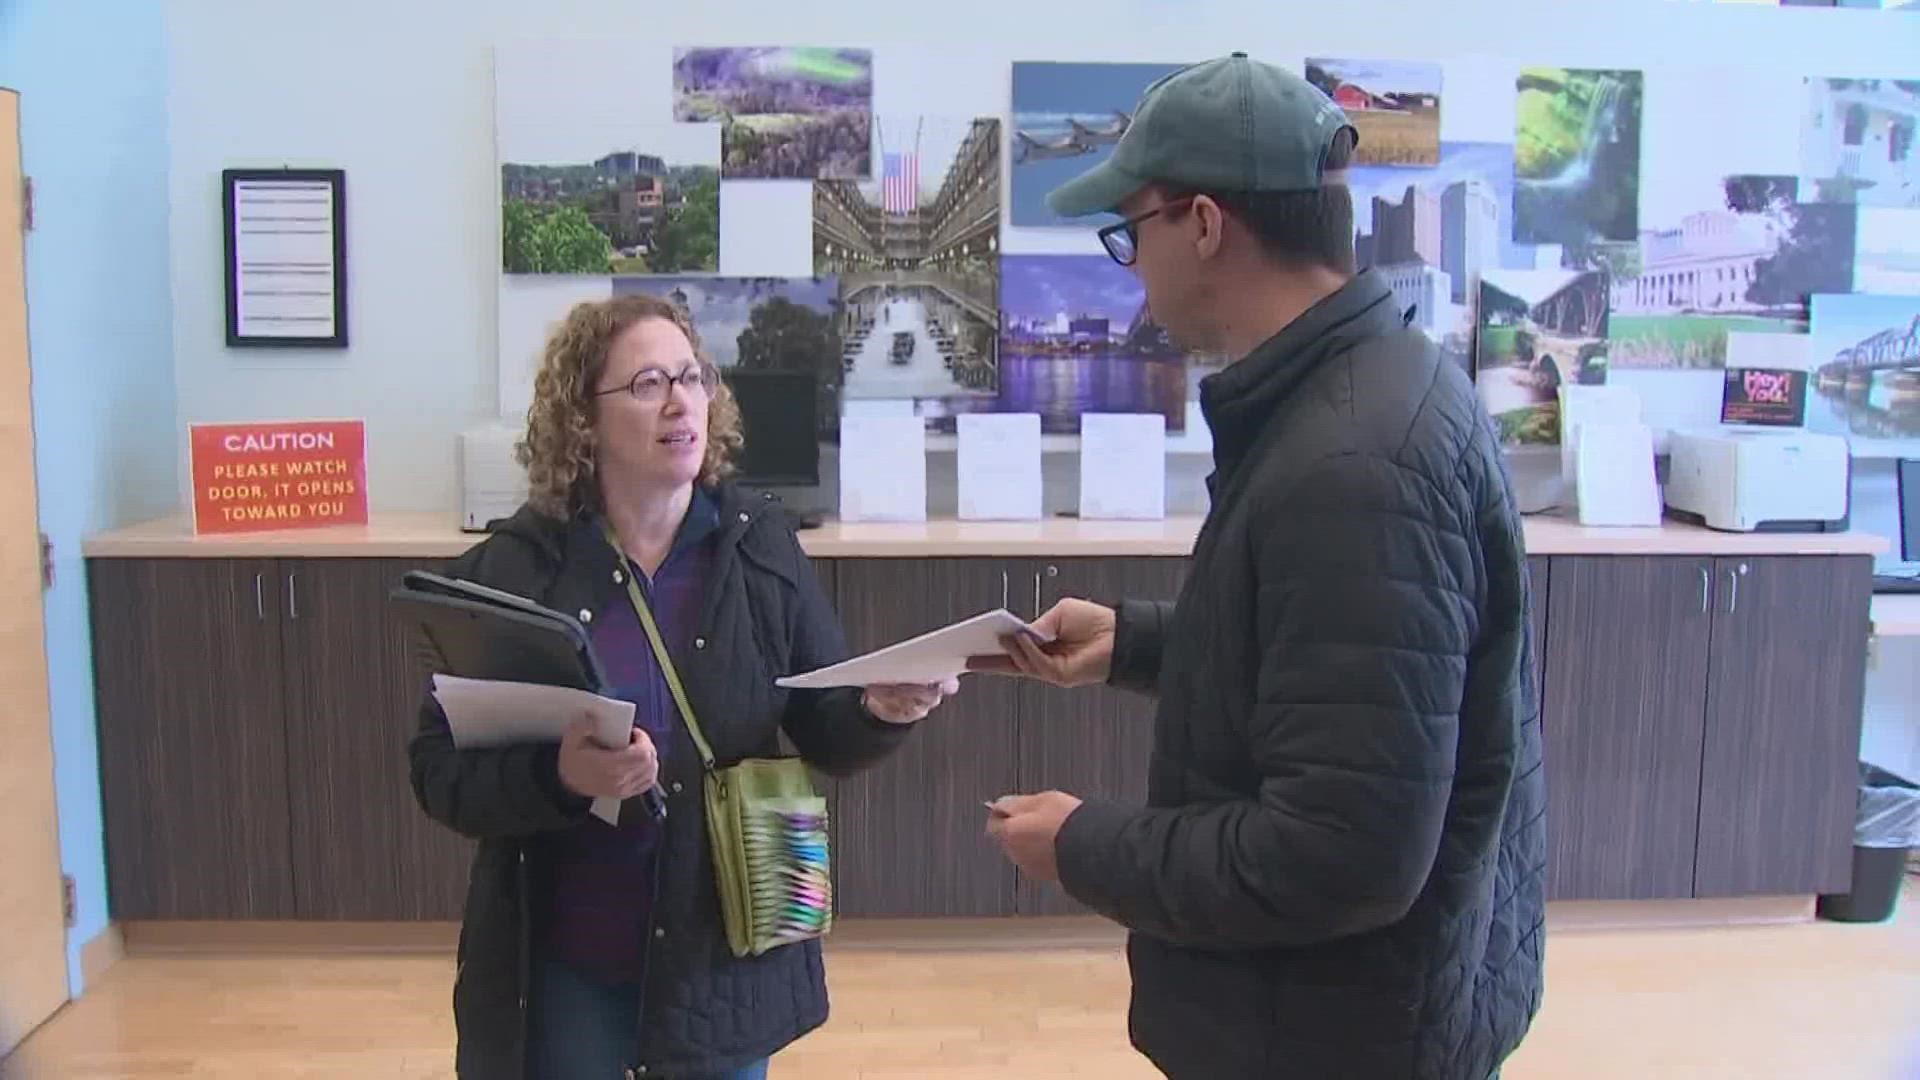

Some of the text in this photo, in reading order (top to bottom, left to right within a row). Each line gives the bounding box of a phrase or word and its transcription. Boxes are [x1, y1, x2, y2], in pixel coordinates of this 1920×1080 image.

[225, 432, 334, 452] CAUTION
[214, 460, 347, 479] PLEASE WATCH
[274, 483, 290, 497] IT
[297, 480, 355, 496] OPENS
[221, 502, 344, 522] TOWARD YOU
